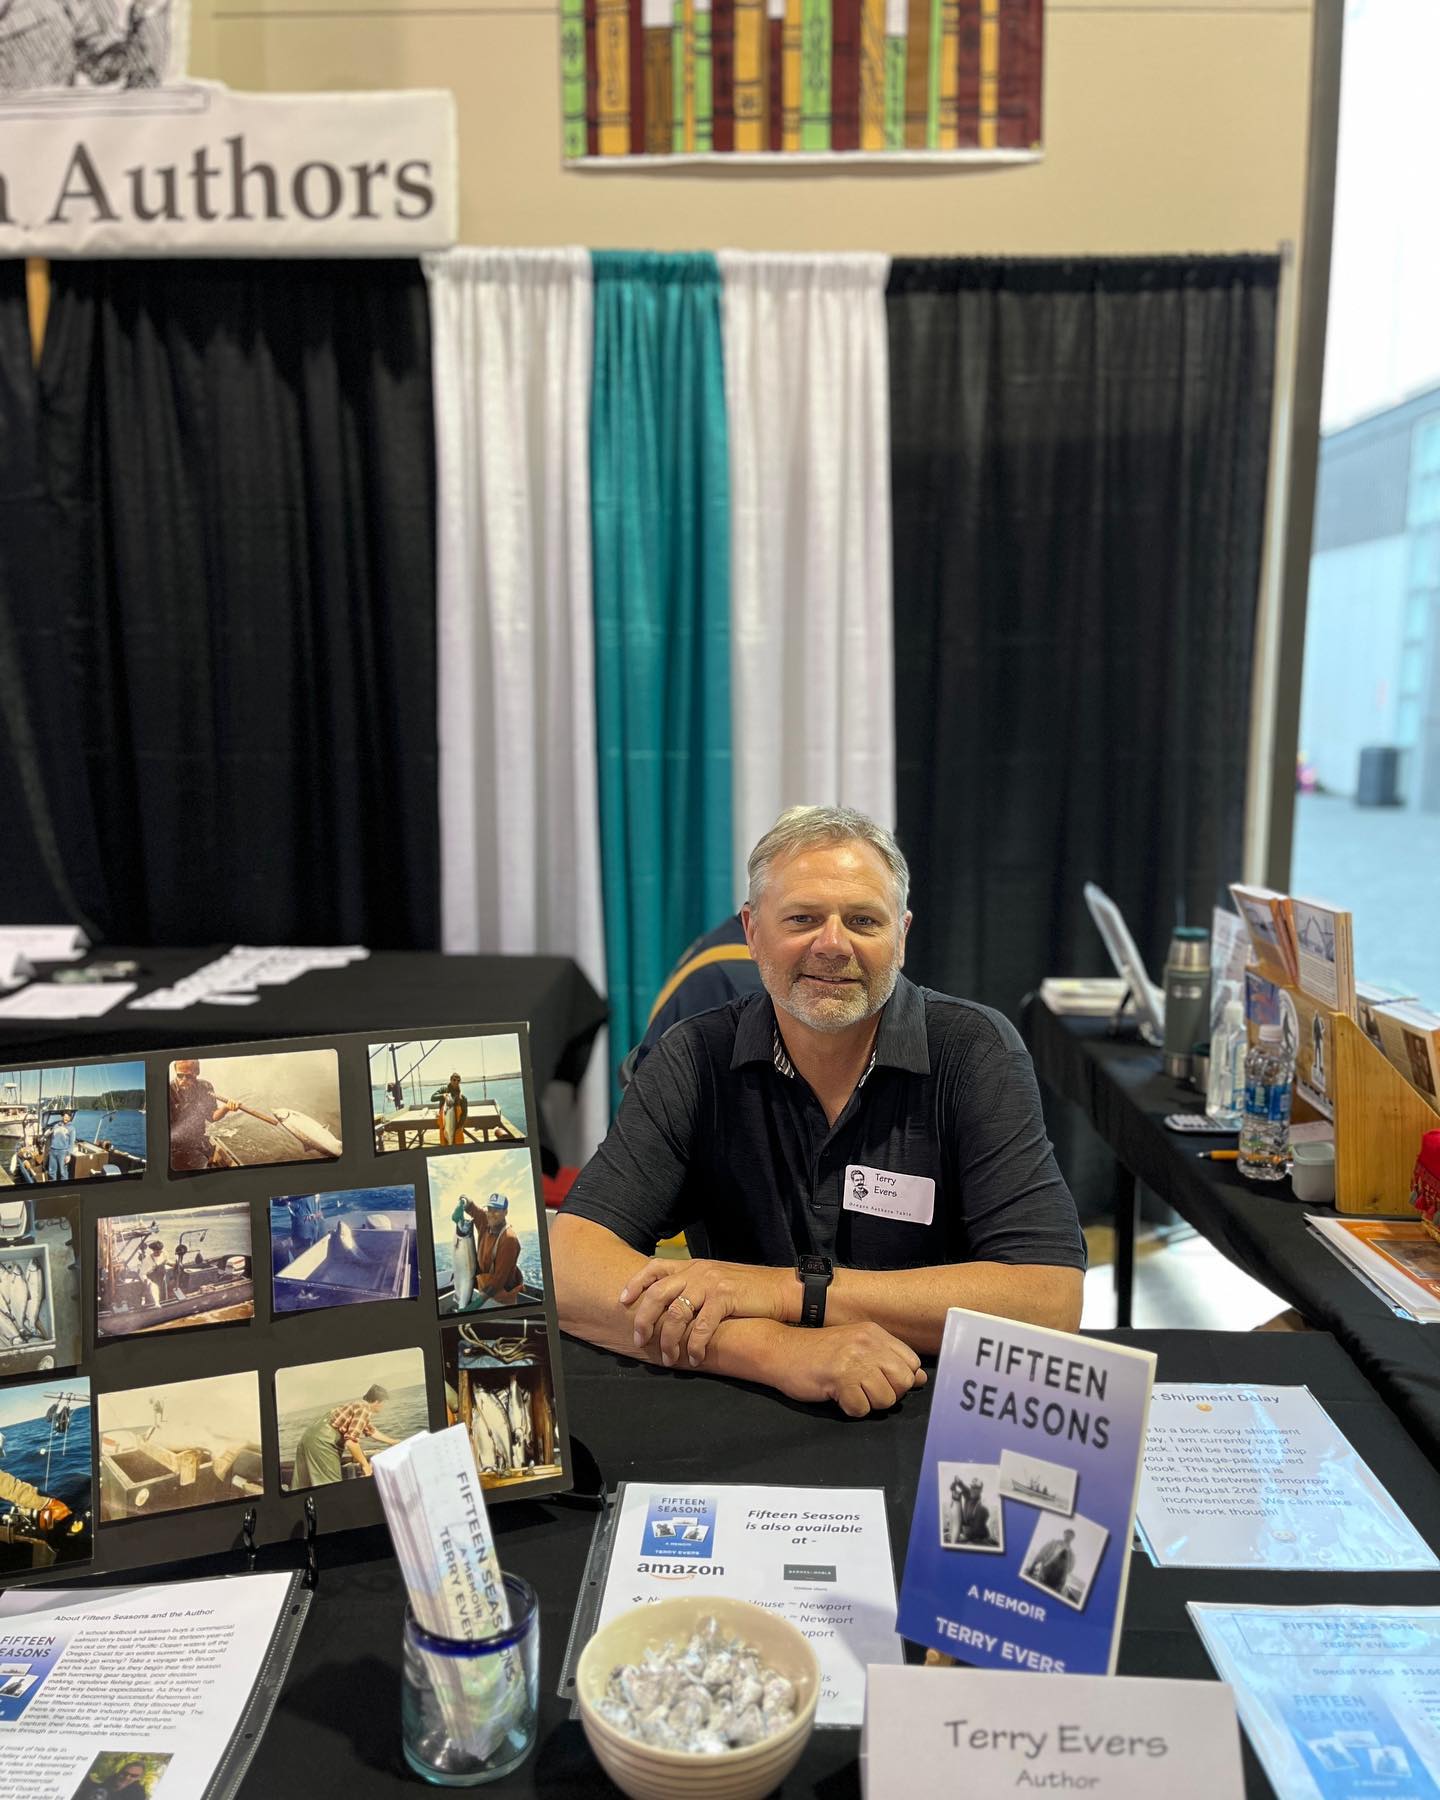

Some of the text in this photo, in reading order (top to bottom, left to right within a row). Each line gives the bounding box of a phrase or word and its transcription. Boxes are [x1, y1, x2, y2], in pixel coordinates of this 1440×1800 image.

[47, 133, 436, 226] Authors
[875, 1173, 897, 1186] Terry
[874, 1185, 897, 1197] Evers
[975, 1337, 1108, 1402] FIFTEEN
[1161, 1393, 1235, 1402] Shipment
[1237, 1394, 1280, 1403] Delay
[959, 1379, 1110, 1450] SEASONS
[1199, 1437, 1251, 1445] currently
[1224, 1447, 1262, 1455] happy
[1212, 1466, 1270, 1474] shipment
[1151, 1475, 1209, 1483] expected
[1185, 1486, 1230, 1494] August
[1302, 1487, 1320, 1495] for
[661, 1497, 706, 1506] FIFTEEN
[1261, 1497, 1285, 1505] We
[657, 1505, 708, 1514] SEASONS
[457, 1471, 488, 1564] FIFTEEN
[748, 1510, 861, 1521] Fifteen Seasons
[745, 1522, 863, 1533] is also available
[791, 1537, 808, 1545] at
[637, 1562, 725, 1576] amazon
[440, 1526, 475, 1641] TERRY EVER
[459, 1548, 483, 1619] A MEMOIR
[799, 1601, 852, 1611] Newport
[967, 1584, 1047, 1623] A MEMOIR
[151, 1611, 168, 1619] and
[184, 1609, 215, 1617] Author
[800, 1615, 854, 1625] Newport
[0, 1635, 56, 1646] FIFTEEN
[936, 1616, 1066, 1674] TERRY EVERS
[0, 1648, 51, 1658] EASONS
[821, 1687, 839, 1699] ity
[1292, 1695, 1367, 1706] FIFTEEN
[944, 1719, 1169, 1760] Terry Evers
[1015, 1769, 1100, 1789] Author
